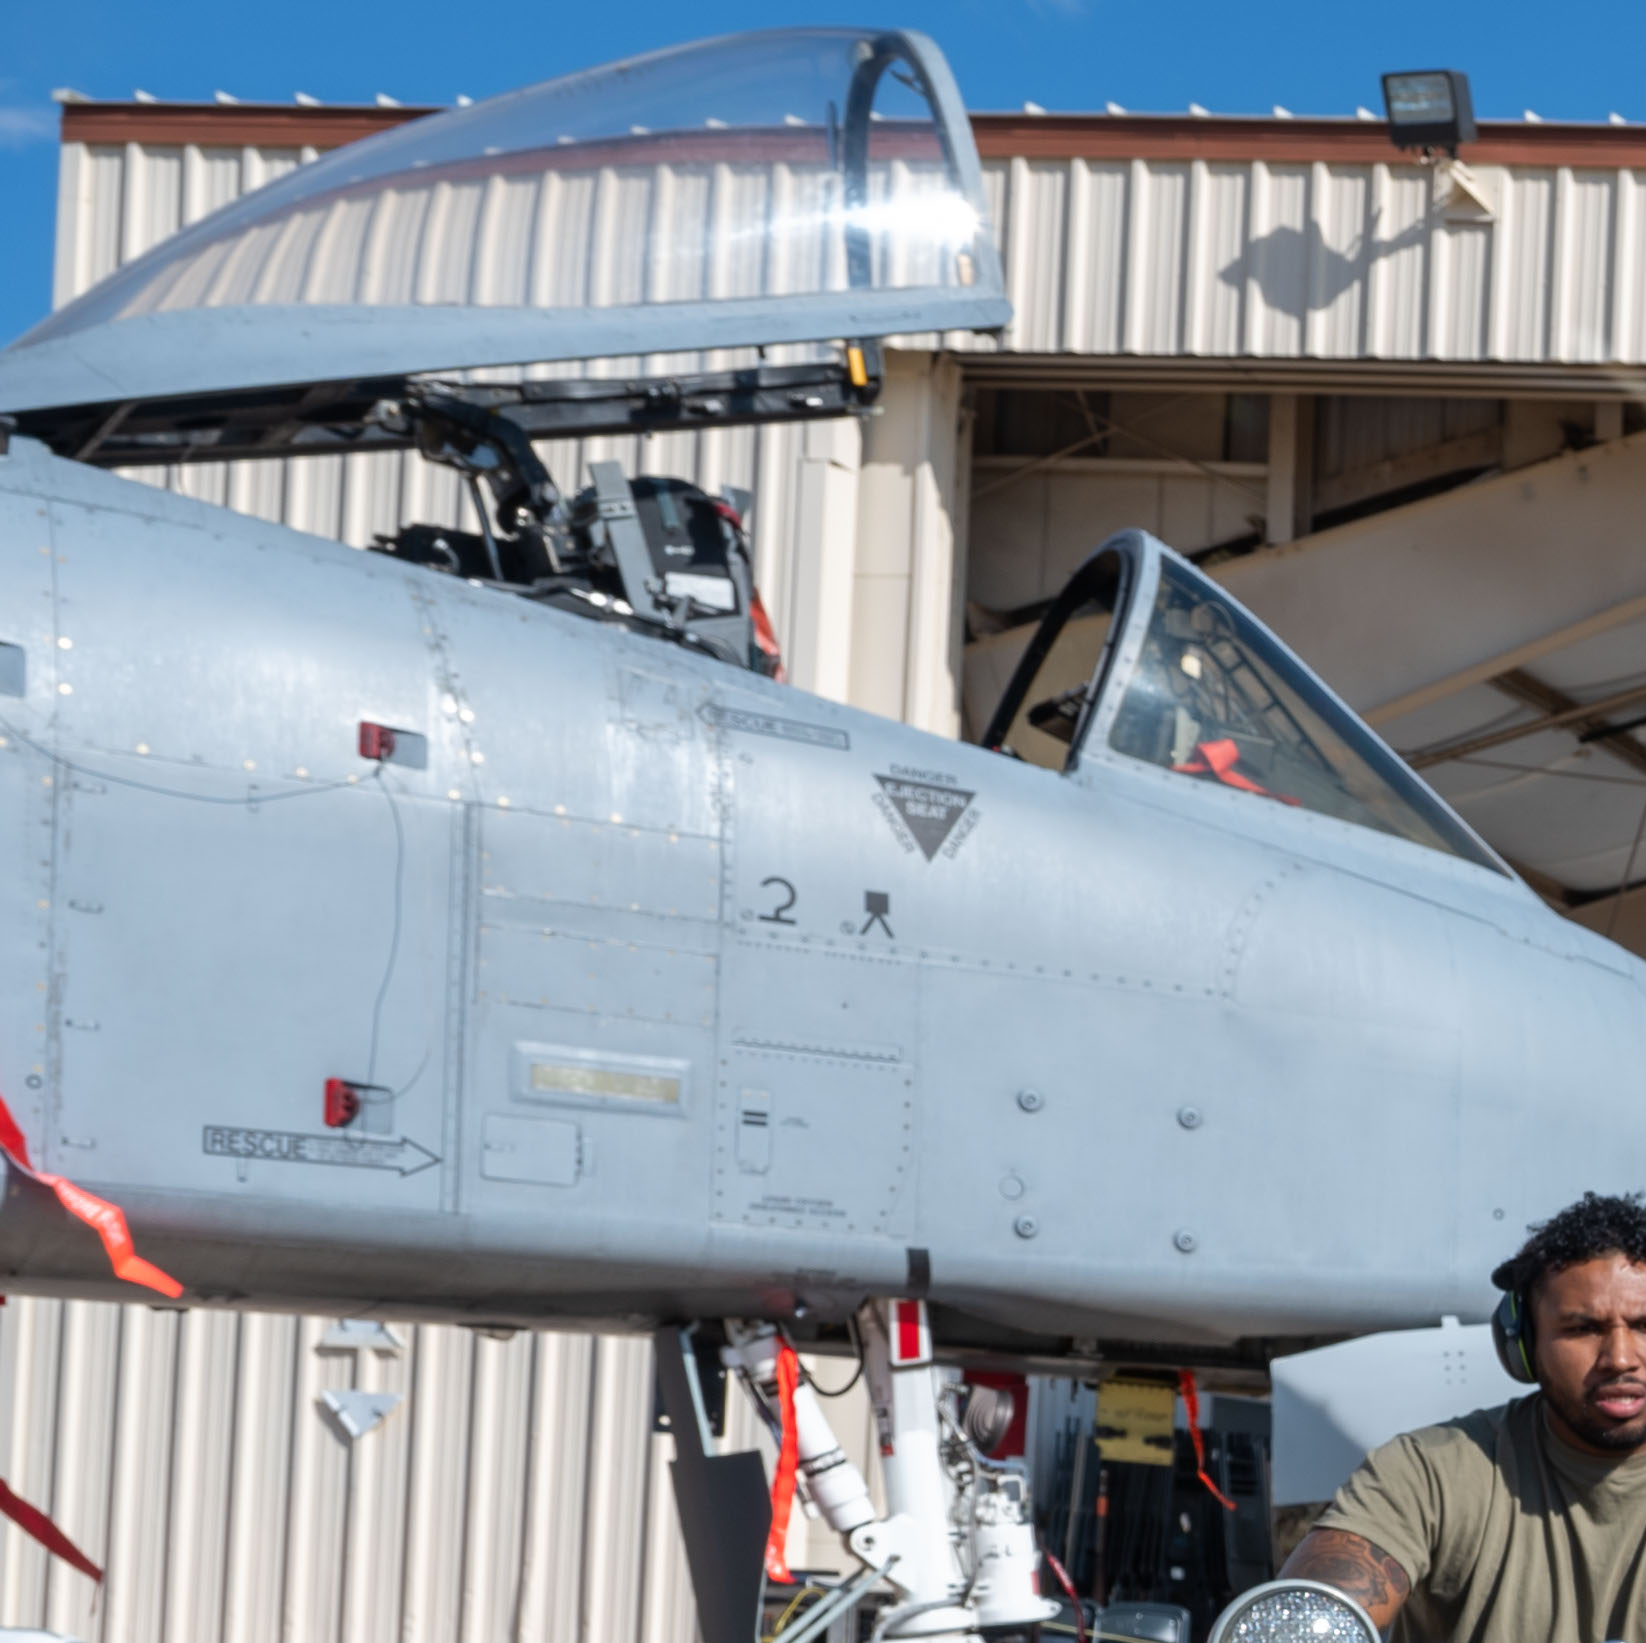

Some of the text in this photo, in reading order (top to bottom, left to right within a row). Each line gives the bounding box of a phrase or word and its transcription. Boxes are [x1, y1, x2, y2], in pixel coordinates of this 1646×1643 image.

[889, 763, 958, 784] DANGER
[884, 781, 967, 808] EJECTION
[905, 800, 948, 820] SEAT
[209, 1130, 308, 1160] RESCUE
